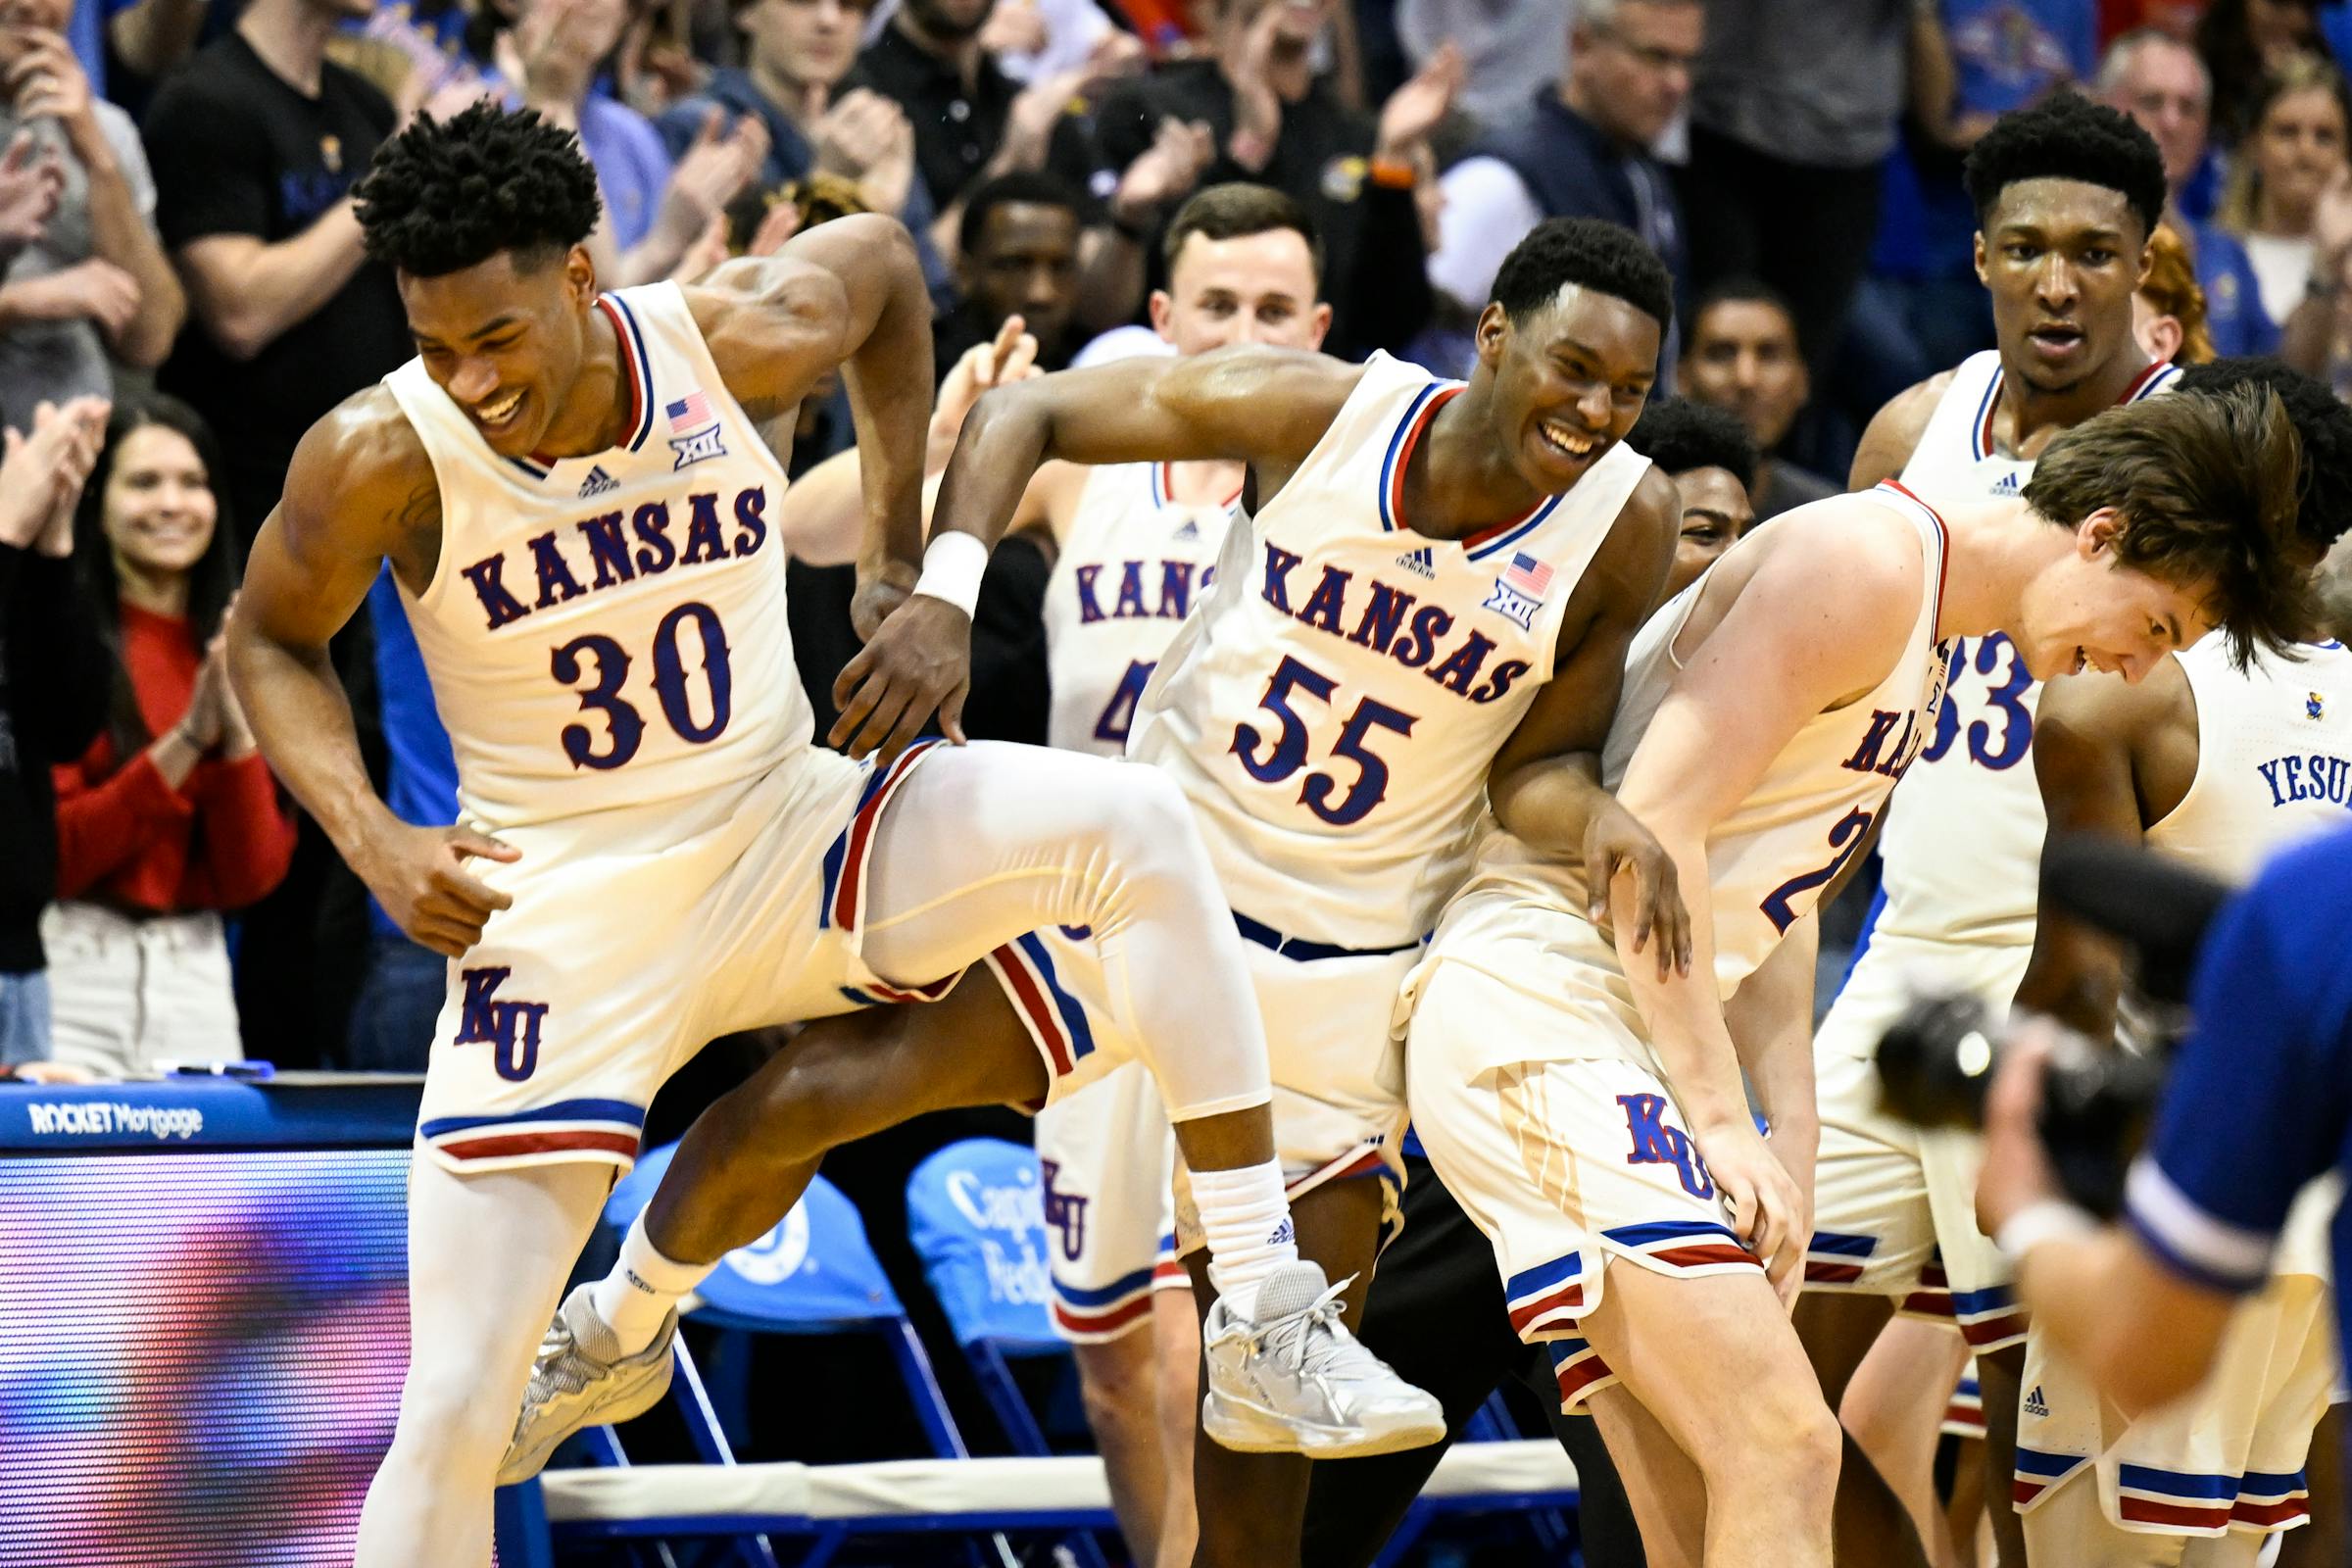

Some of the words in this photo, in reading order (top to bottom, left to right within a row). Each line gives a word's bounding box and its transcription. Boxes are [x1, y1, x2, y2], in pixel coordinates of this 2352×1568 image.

[462, 486, 767, 632] KANSAS
[1260, 539, 1534, 706] KANSAS
[1396, 556, 1436, 581] adidas
[551, 602, 733, 771] 30
[1228, 654, 1421, 826] 55
[454, 966, 550, 1083] KU
[27, 1102, 113, 1135] ROCKET
[112, 1102, 204, 1140] Mortgage
[1616, 1093, 1715, 1201] KU
